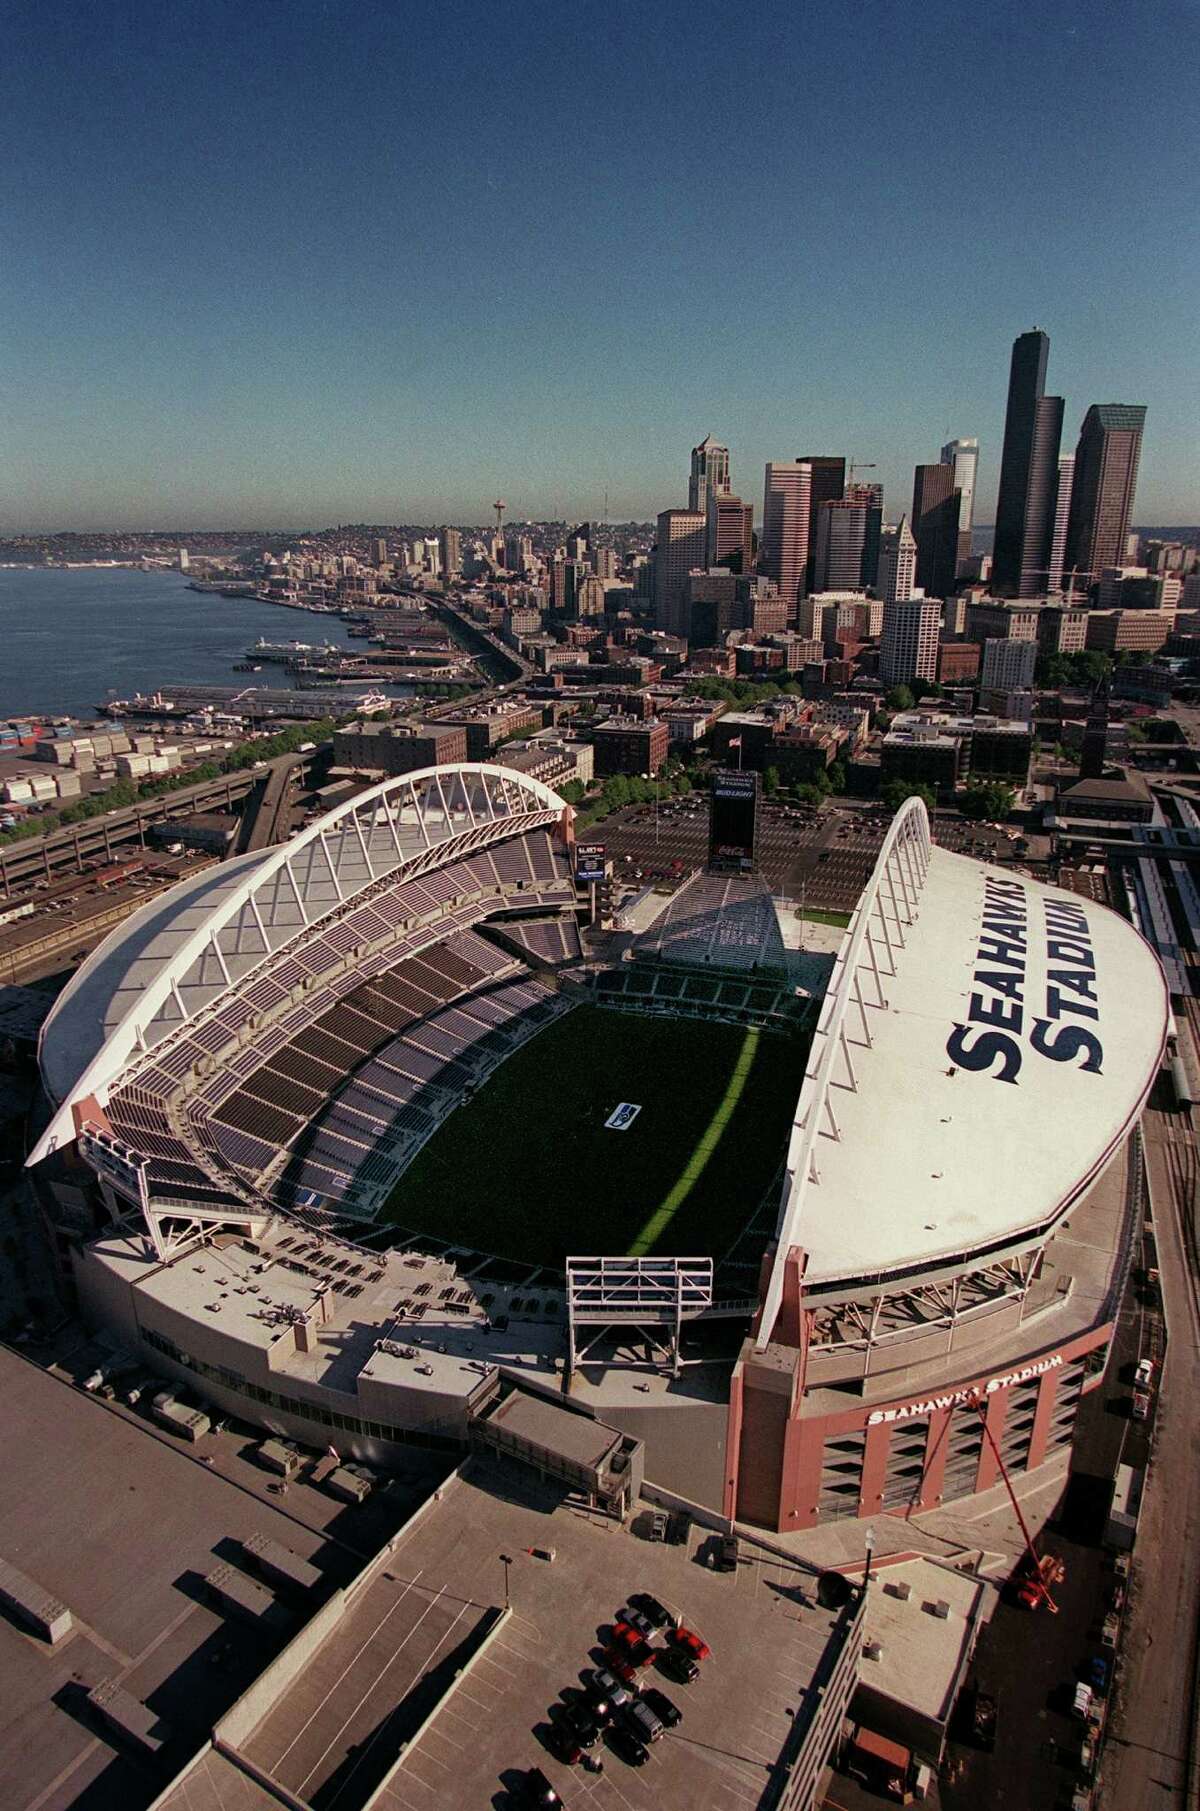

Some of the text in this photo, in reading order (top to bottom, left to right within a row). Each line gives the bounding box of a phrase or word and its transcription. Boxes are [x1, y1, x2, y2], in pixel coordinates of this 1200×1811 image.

[946, 876, 1027, 1085] SEAHAWKS
[1029, 898, 1103, 1075] STADIUM
[985, 1355, 1062, 1394] STADIUM
